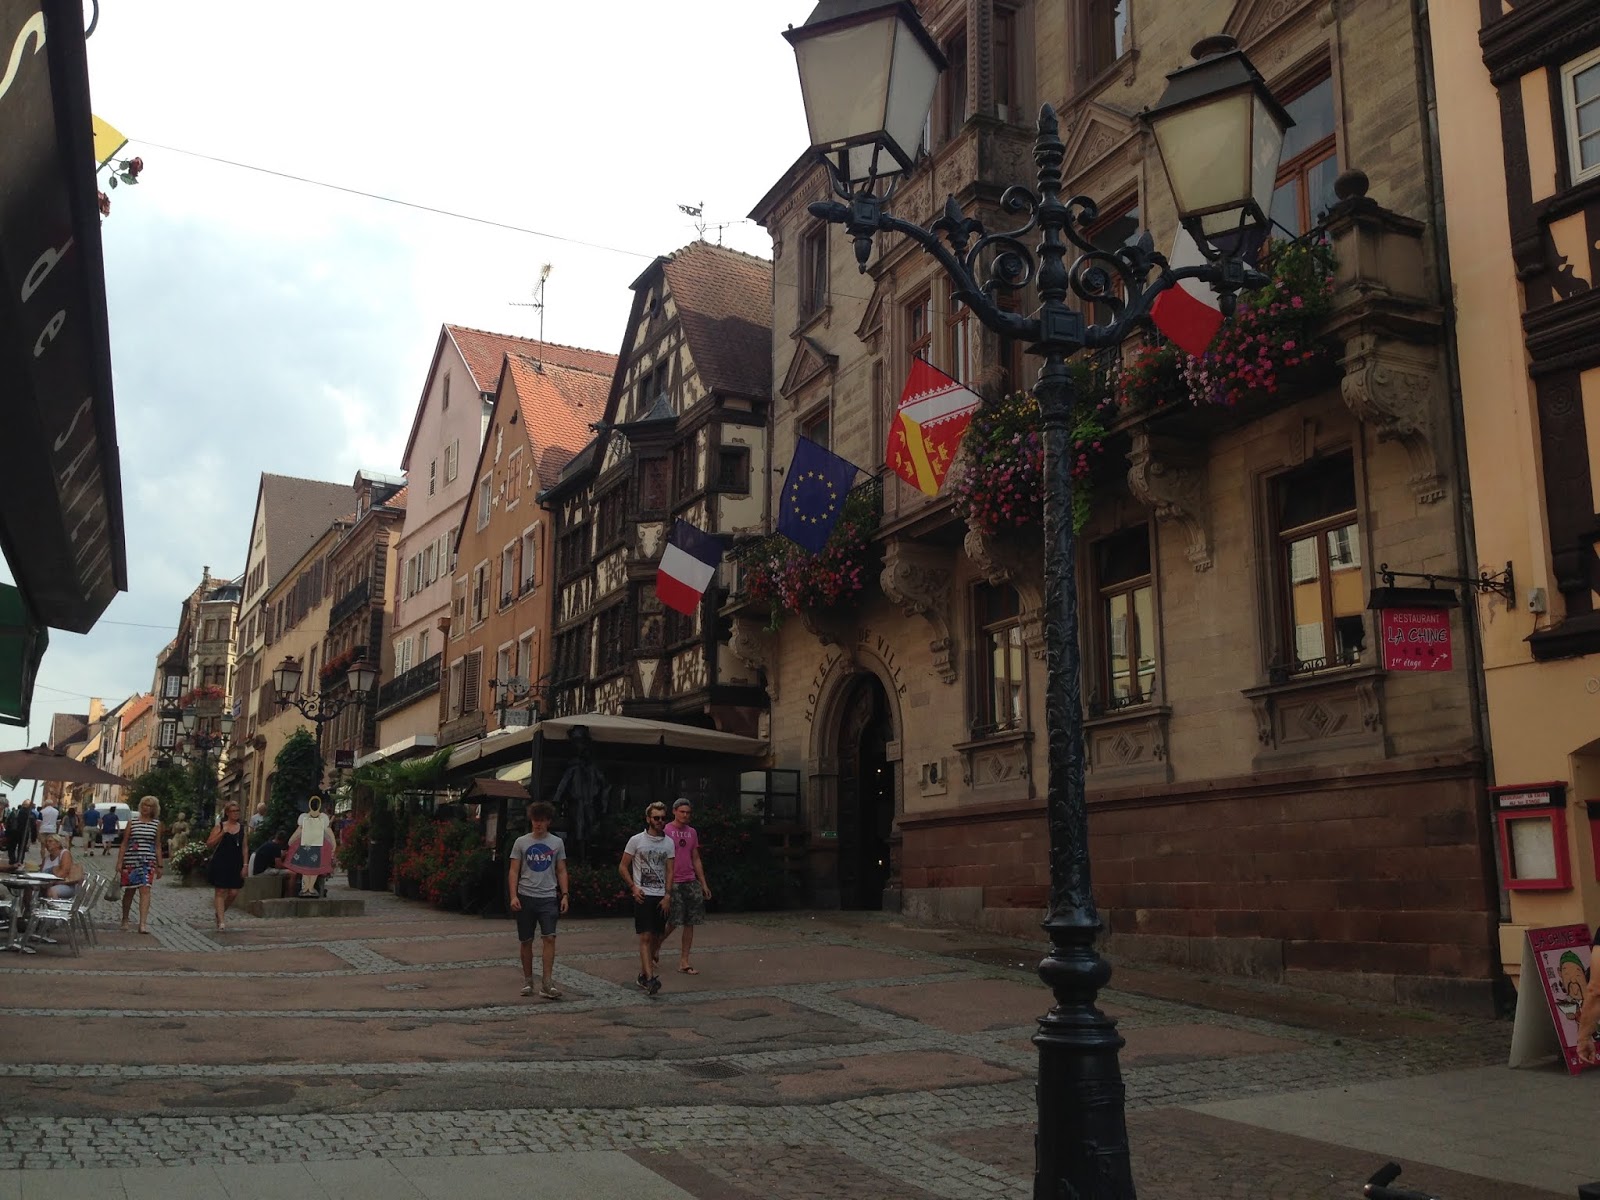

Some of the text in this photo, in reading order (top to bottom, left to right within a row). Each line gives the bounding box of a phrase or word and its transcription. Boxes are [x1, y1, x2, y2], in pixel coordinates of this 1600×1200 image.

[21, 235, 74, 358] de
[54, 396, 112, 600] SAVERNE
[1393, 613, 1440, 623] RESTAURANT
[1388, 626, 1448, 646] LA CHINE
[877, 635, 907, 699] VILLE
[526, 854, 552, 862] NASA
